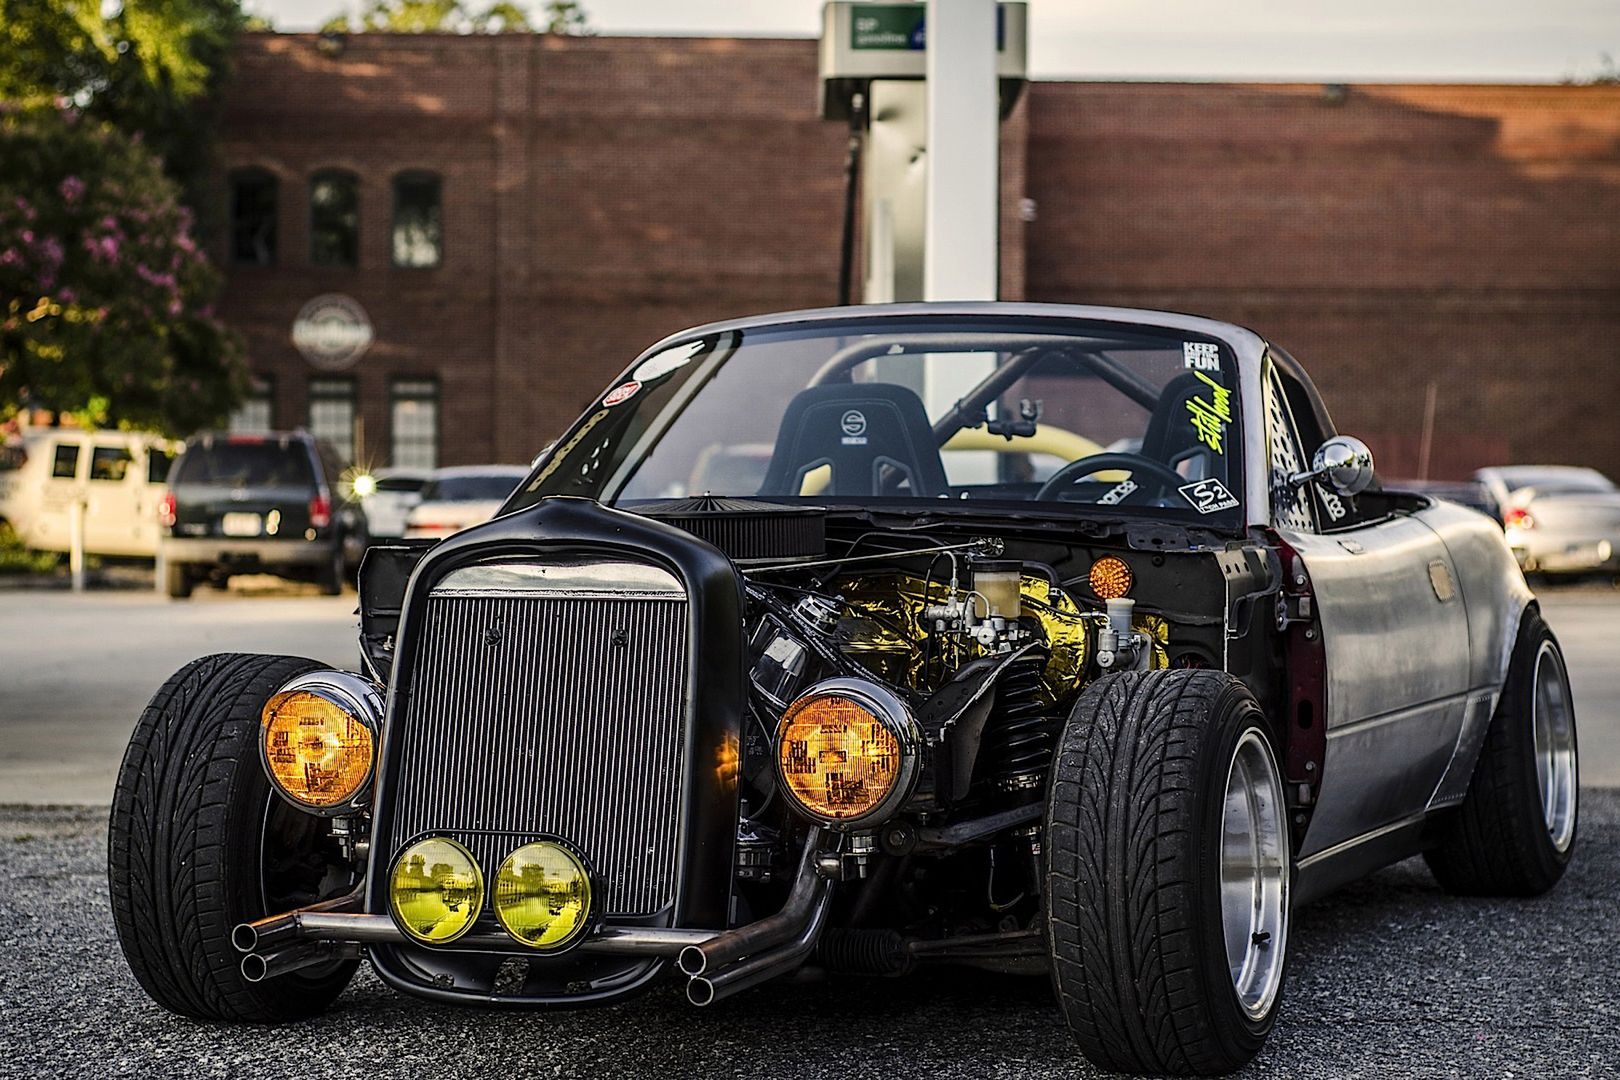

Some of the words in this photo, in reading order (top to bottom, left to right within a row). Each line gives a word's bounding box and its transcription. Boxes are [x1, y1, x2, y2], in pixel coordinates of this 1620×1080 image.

[1183, 341, 1219, 354] KEEP
[1184, 357, 1220, 371] FUN
[1096, 480, 1139, 505] arco
